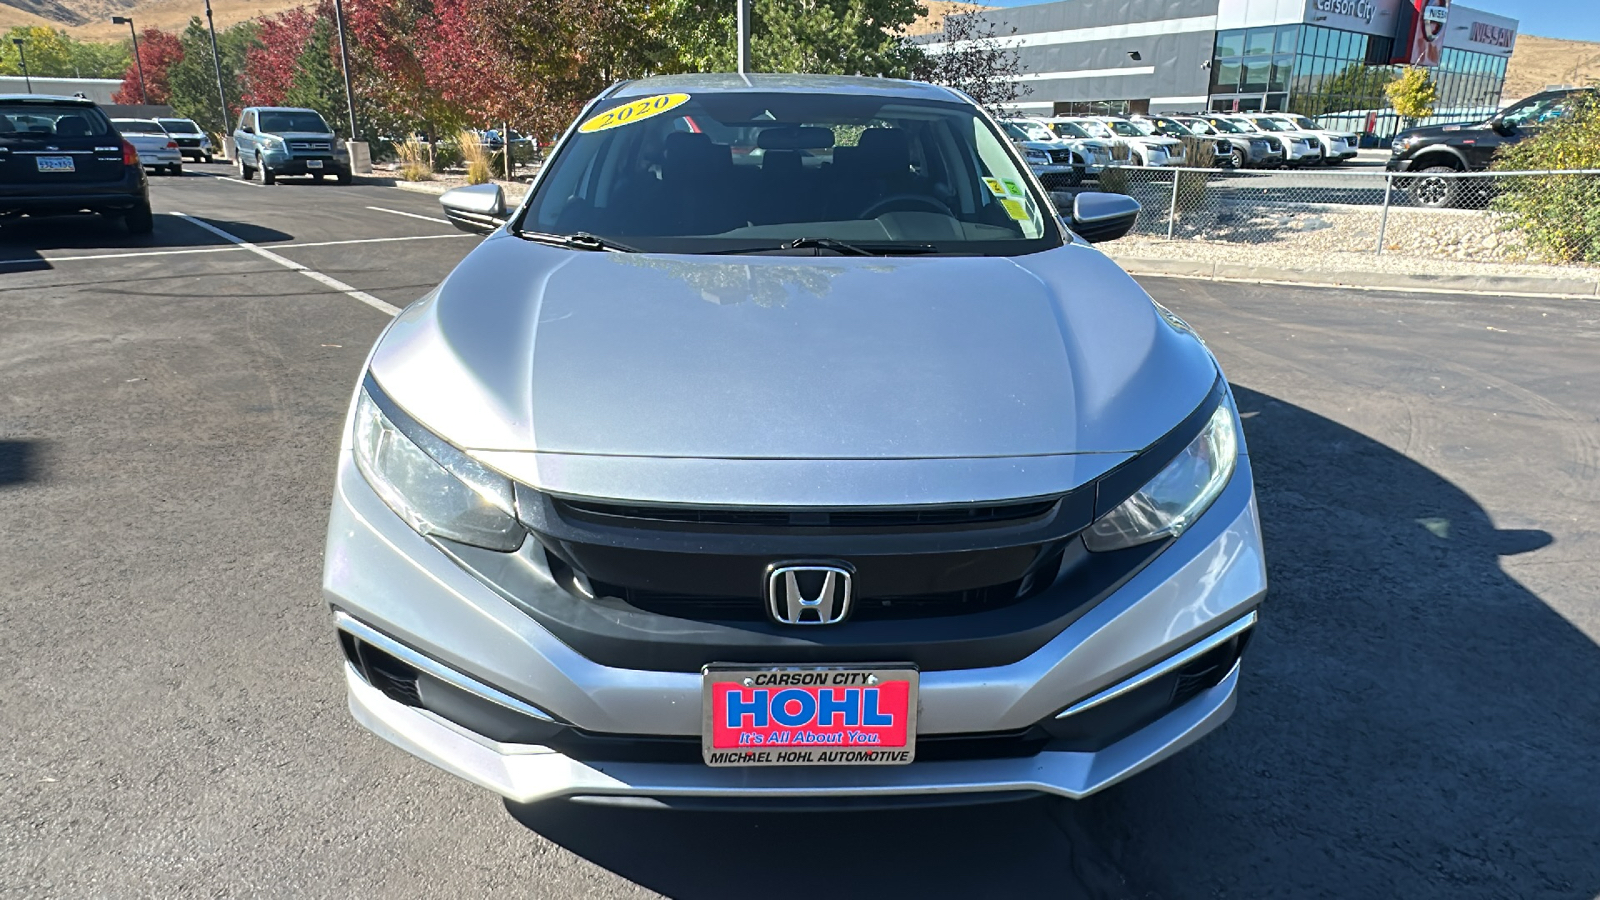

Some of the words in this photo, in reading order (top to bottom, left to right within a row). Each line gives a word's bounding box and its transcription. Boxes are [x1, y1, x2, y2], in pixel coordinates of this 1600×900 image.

[1317, 0, 1355, 16] Carson
[1357, 0, 1377, 24] City
[1471, 22, 1514, 47] NISSAN
[599, 96, 669, 128] 2020
[754, 673, 829, 686] CARSON
[832, 672, 872, 686] CITY
[726, 688, 893, 728] HOHL
[739, 732, 763, 744] It's
[767, 731, 789, 743] All
[792, 731, 843, 744] About
[847, 730, 881, 743] You.
[710, 752, 773, 763] MICHAEL
[776, 752, 814, 763] HOHL
[817, 751, 910, 763] AUTOMOTIVE
